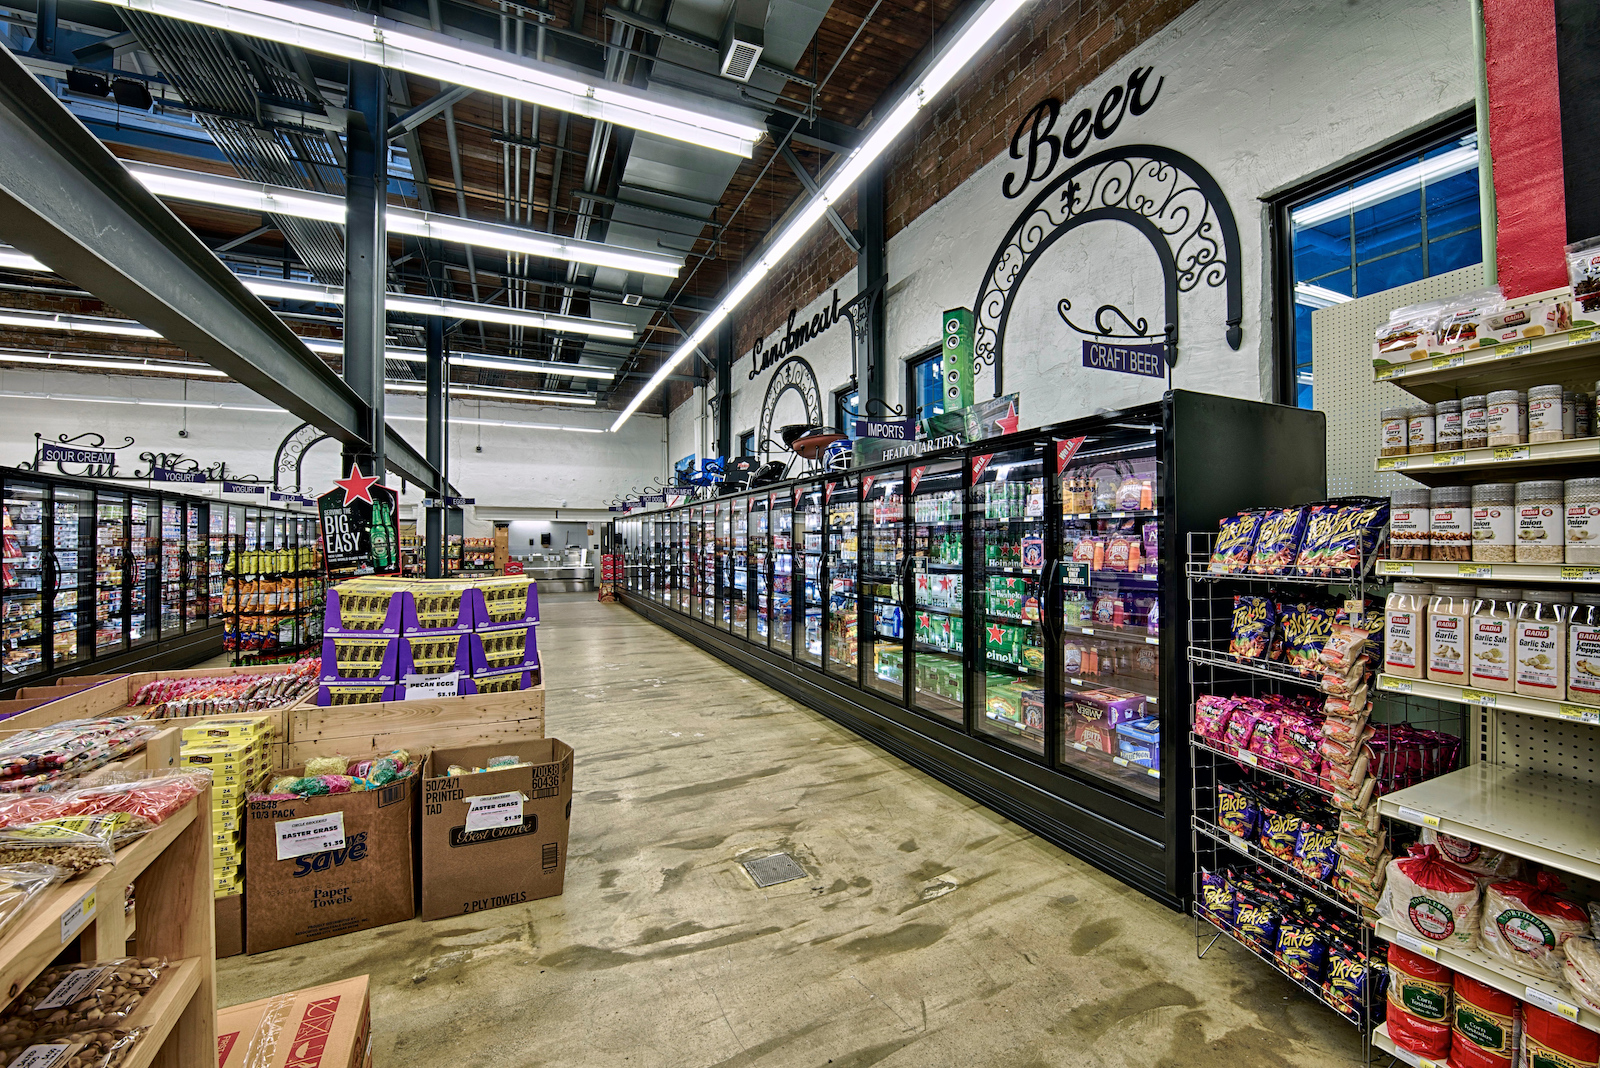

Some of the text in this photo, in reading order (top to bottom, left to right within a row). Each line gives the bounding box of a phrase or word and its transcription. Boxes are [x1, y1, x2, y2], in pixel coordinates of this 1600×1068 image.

[1003, 66, 1164, 199] Beer
[1505, 312, 1524, 322] BADIA
[749, 289, 841, 380] Lunchmeat
[1090, 344, 1159, 375] CRAFT BEER
[868, 422, 904, 439] IMPORTS
[883, 432, 962, 461] HEADQUARTERS
[46, 450, 74, 461] SOUR
[76, 452, 112, 464] CREAM
[134, 451, 230, 480] Mat
[165, 473, 195, 482] YOGURT
[232, 485, 256, 493] YOGURT
[325, 514, 349, 535] BIG
[1256, 510, 1299, 548] Takis
[326, 532, 360, 553] EASY
[1232, 602, 1267, 632] Takis
[1391, 627, 1411, 635] Garlic
[1435, 632, 1458, 640] Garlic
[1474, 634, 1492, 642] Garlic
[1526, 629, 1547, 637] BADIA
[1519, 639, 1555, 649] Garlic Salt
[1576, 646, 1600, 654] Peppe
[1076, 703, 1103, 719] AMBER
[532, 764, 559, 778] 70038
[426, 777, 460, 791] 50/24/1
[532, 777, 559, 789] 60436
[426, 789, 464, 803] PRINTED
[1218, 793, 1247, 813] Takis
[272, 809, 295, 818] PACK
[426, 803, 442, 815] TAD
[282, 830, 311, 839] EASTER
[314, 825, 338, 834] GRASS
[1267, 815, 1299, 834] Takis
[457, 822, 532, 843] Best Choice
[1302, 832, 1336, 854] Takis
[293, 842, 368, 878] Save
[313, 887, 350, 898] Paper
[1203, 885, 1233, 906] Takis
[311, 895, 353, 909] Towels
[464, 891, 527, 912] 2 PLY TOWELS
[1236, 903, 1271, 926] Takis
[1426, 914, 1446, 928] Mejor
[1503, 910, 1551, 938] TORTILLERIA
[1279, 926, 1315, 948] Takis
[1506, 924, 1540, 943] La Mejor
[1417, 994, 1432, 1005] Corn
[1469, 1021, 1486, 1033] Corn
